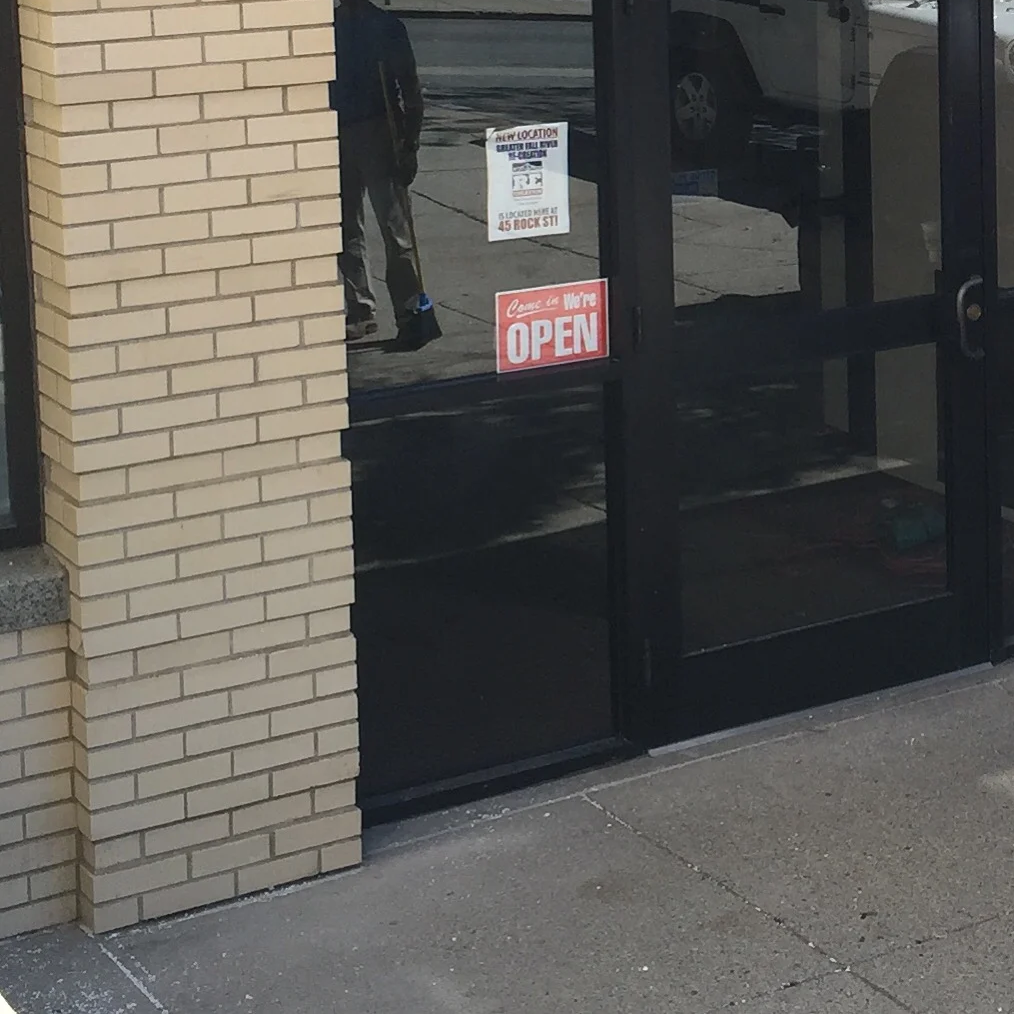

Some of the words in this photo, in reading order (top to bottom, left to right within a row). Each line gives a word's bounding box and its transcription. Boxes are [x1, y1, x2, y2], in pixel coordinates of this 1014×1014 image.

[496, 131, 516, 142] NEW
[517, 127, 558, 140] LOCATION
[505, 209, 532, 219] LOCATED
[498, 220, 512, 232] 45
[514, 217, 541, 230] ROCK
[507, 298, 540, 317] Come
[546, 296, 559, 306] in
[563, 292, 596, 310] We're
[507, 312, 598, 364] OPEN
